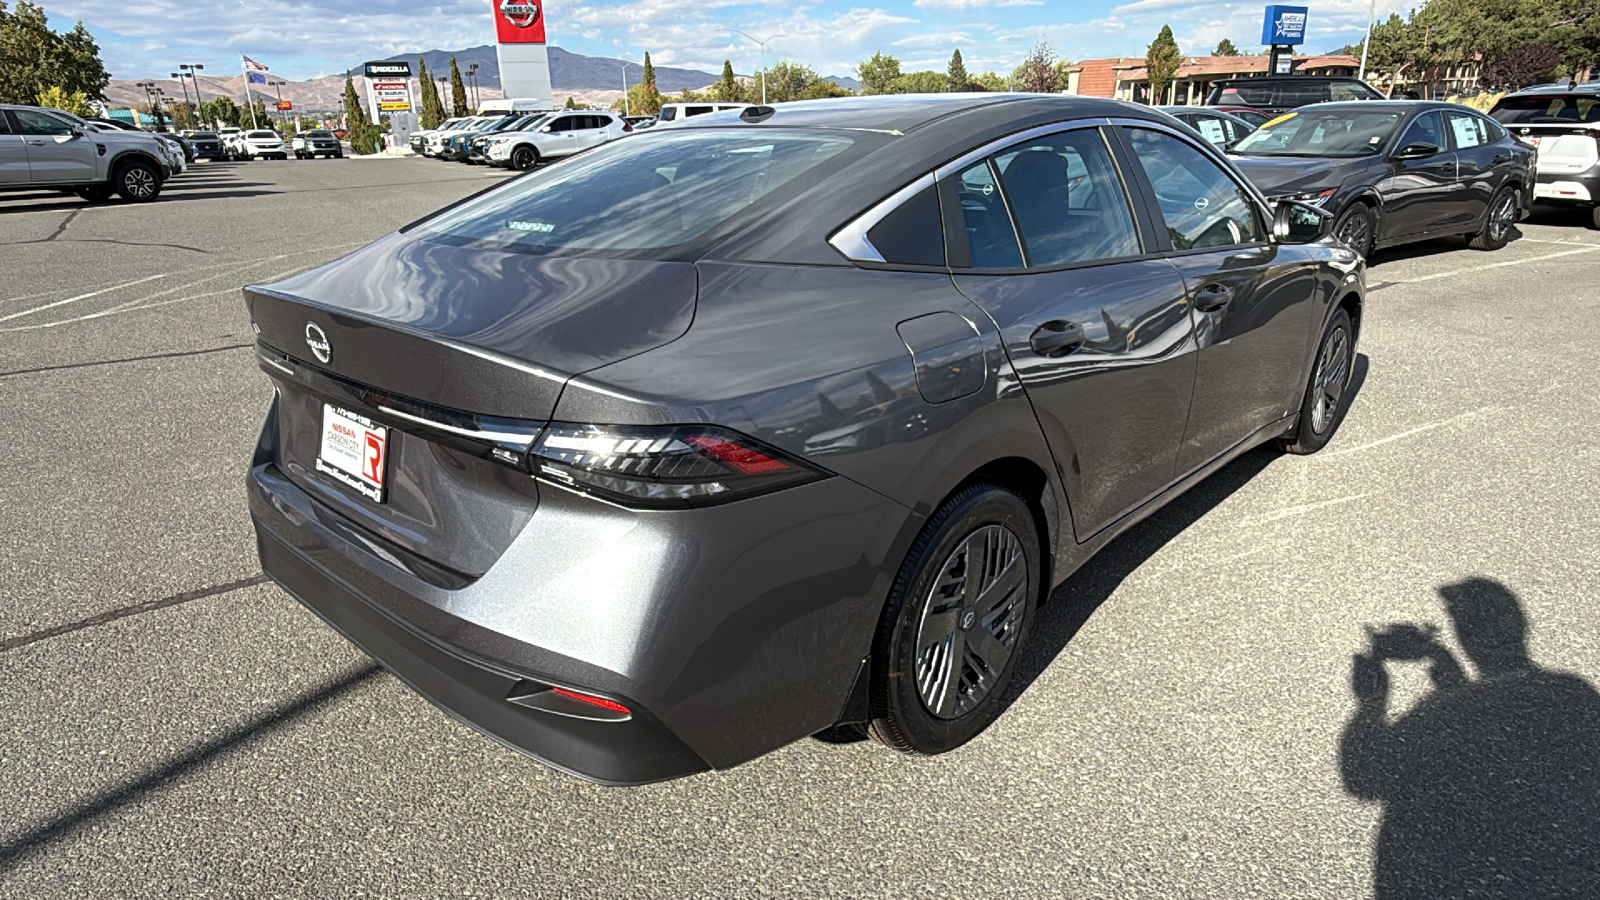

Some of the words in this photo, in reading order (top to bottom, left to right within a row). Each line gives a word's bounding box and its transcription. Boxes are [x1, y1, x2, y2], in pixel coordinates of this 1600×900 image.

[332, 423, 355, 439] NISSAN
[327, 431, 348, 447] CARSON
[348, 439, 359, 451] CITY
